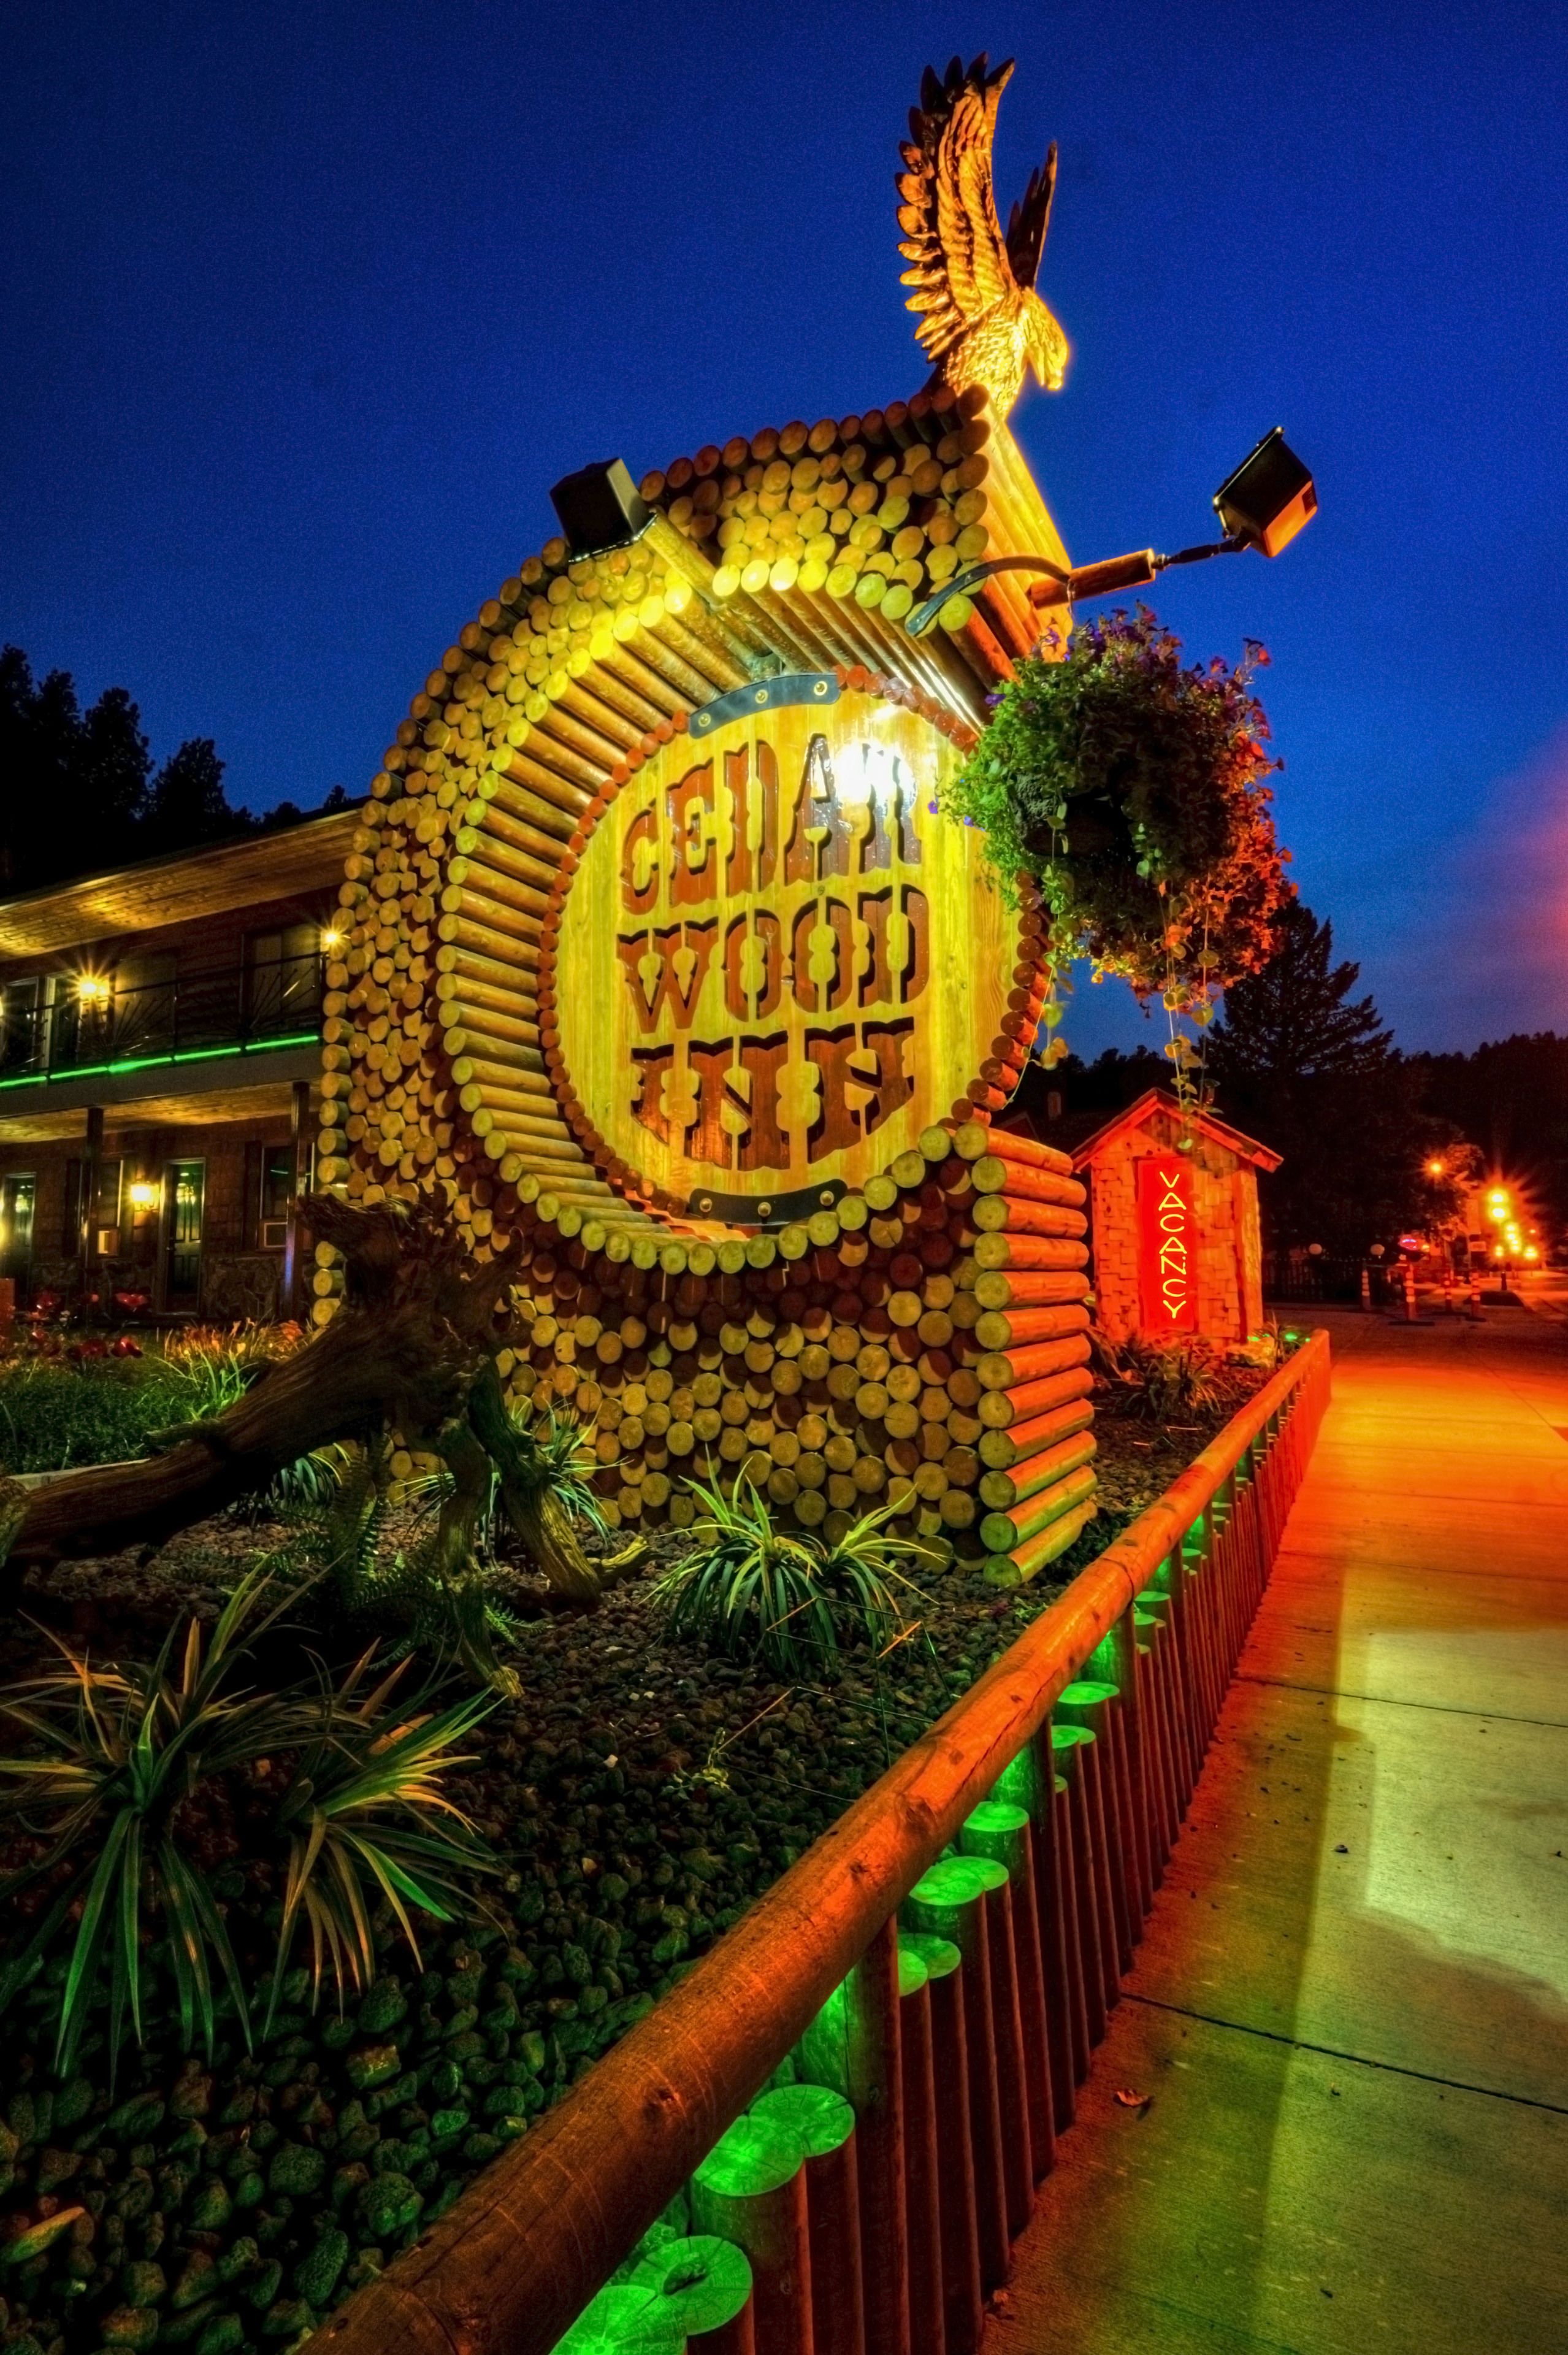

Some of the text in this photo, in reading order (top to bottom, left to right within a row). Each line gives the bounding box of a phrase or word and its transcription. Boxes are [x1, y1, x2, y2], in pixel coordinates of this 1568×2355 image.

[620, 733, 922, 915] CEDAR
[617, 883, 929, 1034] WOOD
[630, 1016, 914, 1171] INN
[1158, 1171, 1188, 1319] VACANCY
